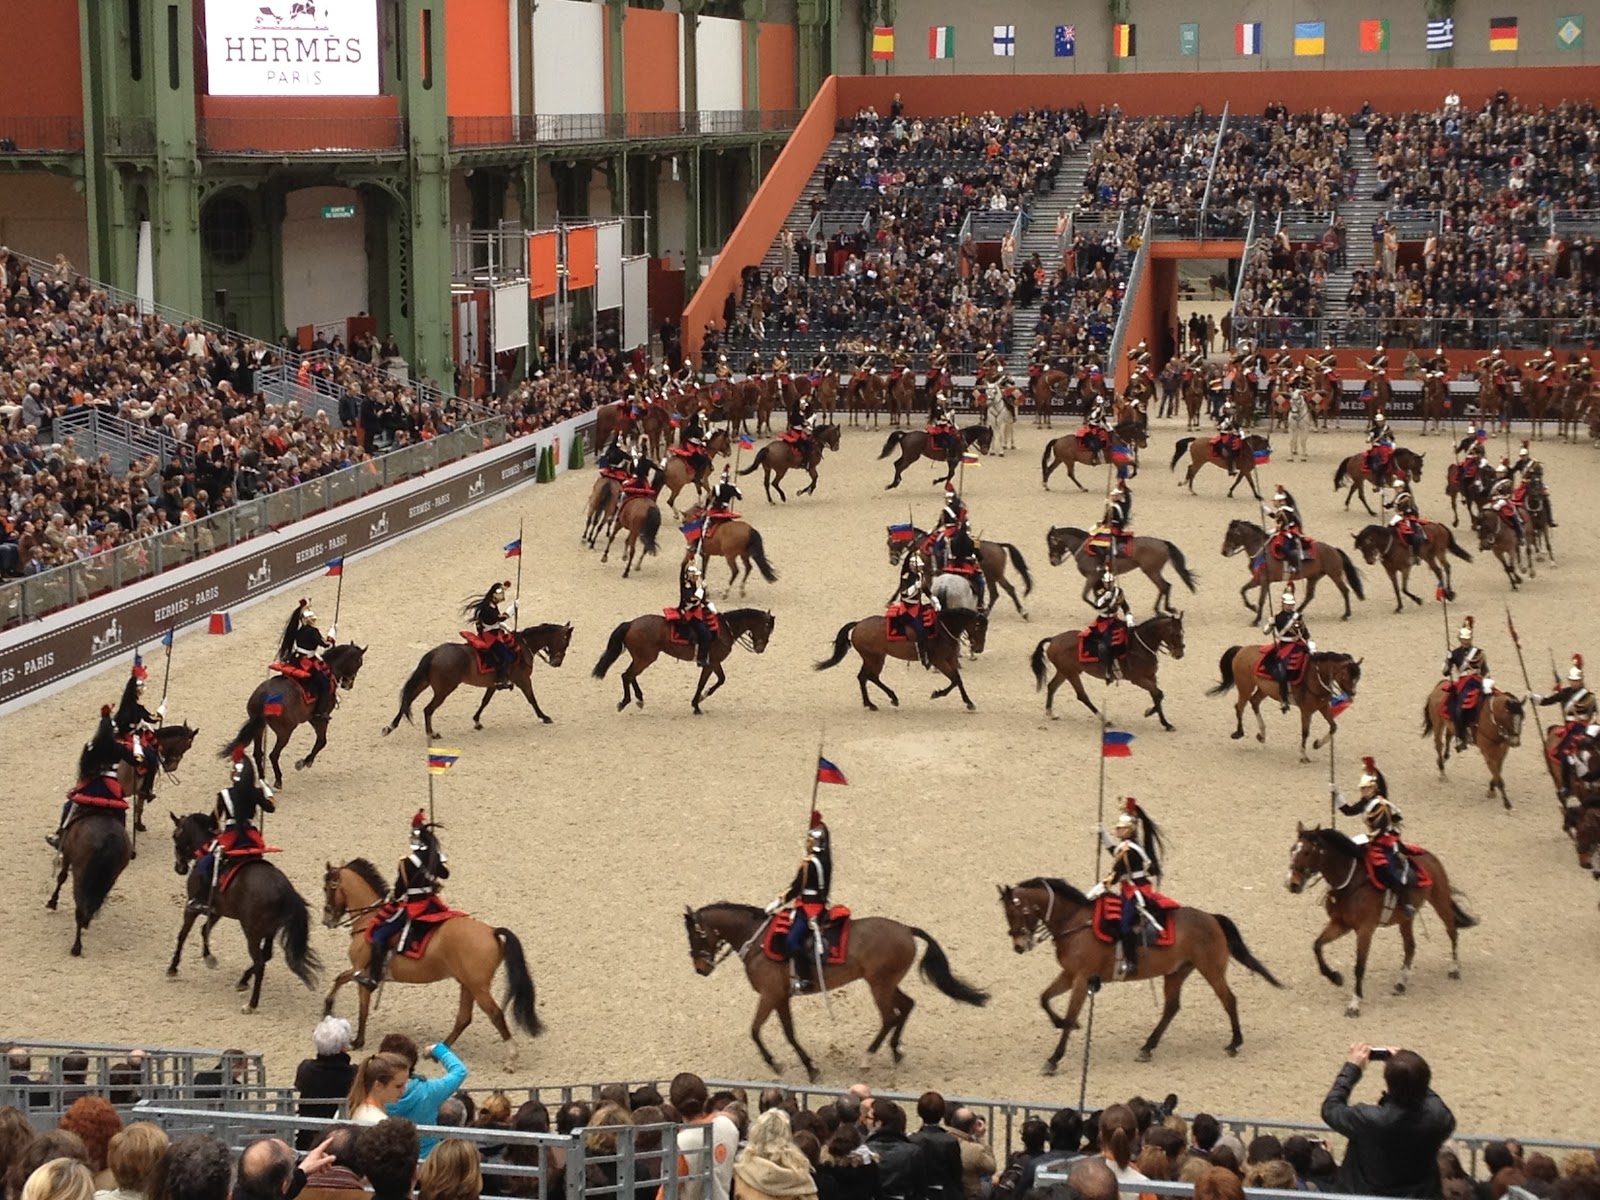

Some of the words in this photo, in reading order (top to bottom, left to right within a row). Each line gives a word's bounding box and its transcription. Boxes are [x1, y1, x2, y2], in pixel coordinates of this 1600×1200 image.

[224, 34, 361, 63] HERMÈS
[267, 70, 322, 85] PARIS
[1385, 402, 1414, 411] ARIS
[328, 534, 347, 550] PARIS
[195, 586, 219, 605] PARIS
[23, 652, 55, 675] PARIS
